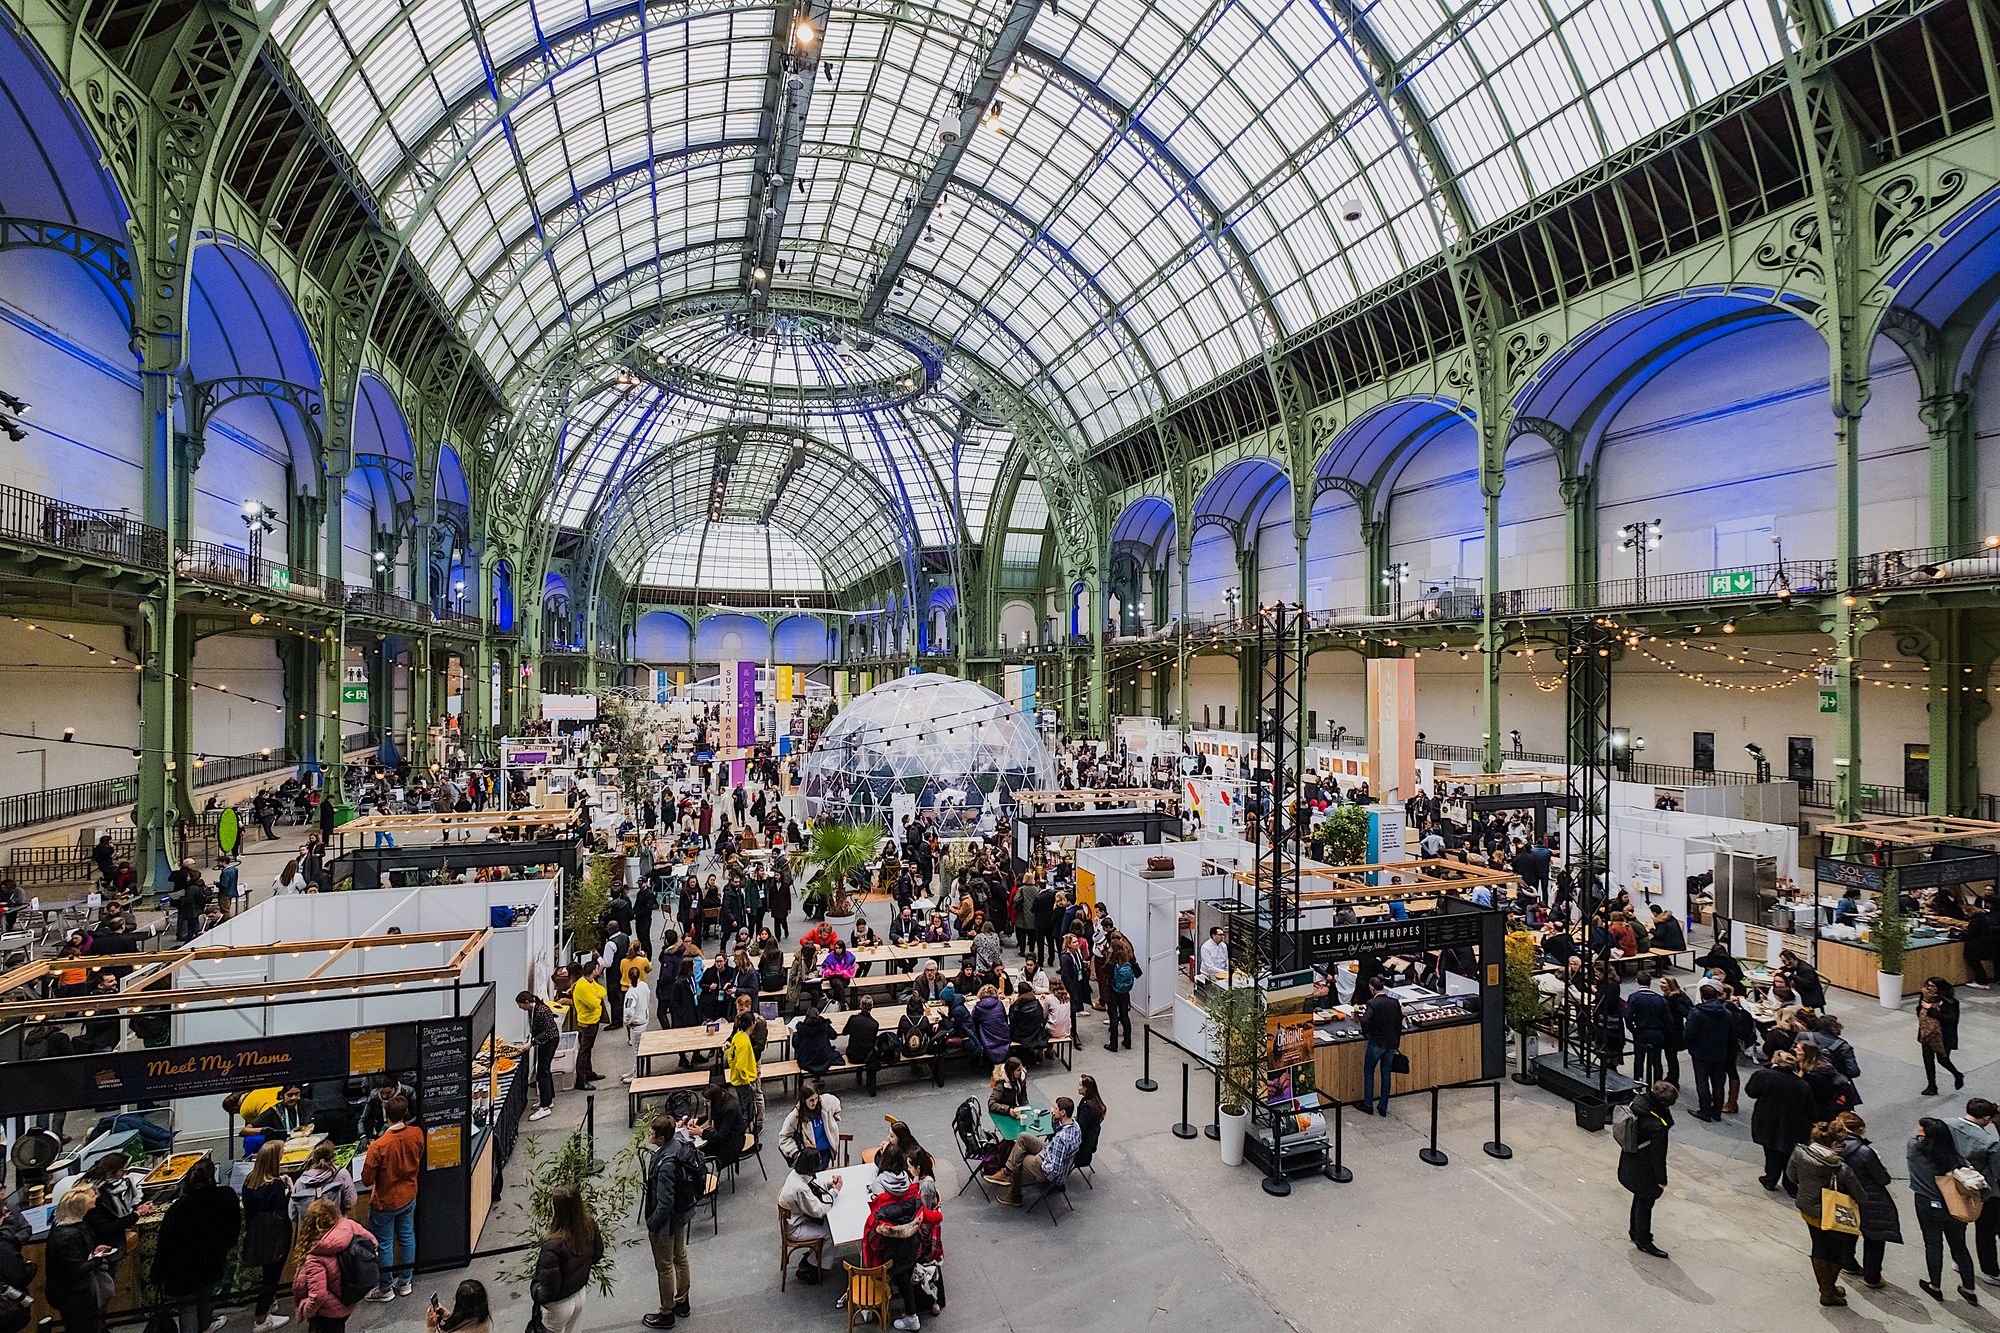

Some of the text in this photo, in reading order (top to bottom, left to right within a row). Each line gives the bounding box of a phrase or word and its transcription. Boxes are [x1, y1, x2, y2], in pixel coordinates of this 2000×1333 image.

[1835, 872, 1868, 885] SEMILLA
[1839, 864, 1864, 877] SOL
[1312, 934, 1331, 946] LES
[1337, 926, 1420, 943] PHILANTHROPES
[1277, 1028, 1304, 1047] ORIGINE
[148, 1052, 292, 1076] Meet My Mama
